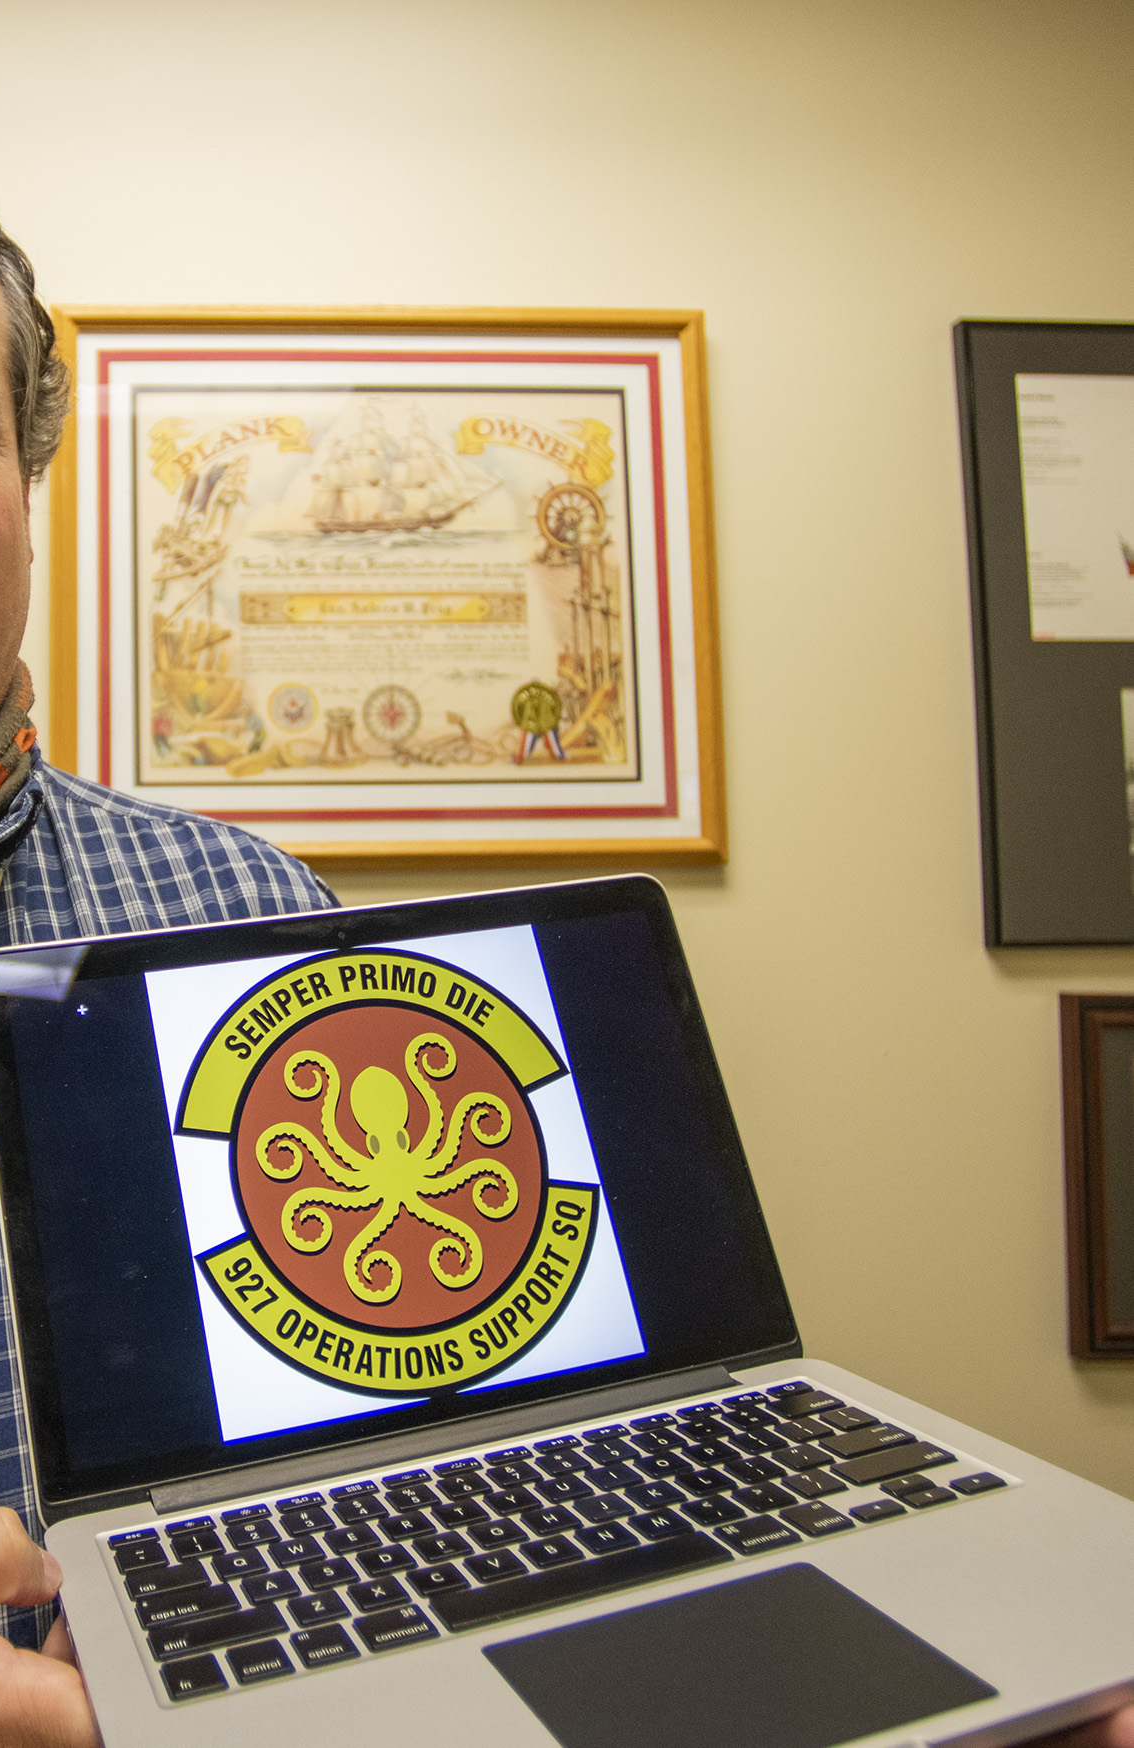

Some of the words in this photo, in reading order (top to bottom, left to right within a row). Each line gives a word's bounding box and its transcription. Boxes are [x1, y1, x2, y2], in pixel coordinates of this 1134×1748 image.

[173, 417, 291, 475] PLANK
[472, 417, 595, 484] OWNER
[224, 971, 333, 1060] SEMPER
[338, 963, 437, 999] PRIMO
[445, 981, 495, 1028] DIE
[224, 1256, 279, 1314] 927
[275, 1308, 465, 1380] OPERATIONS
[468, 1243, 571, 1360] SUPPORT
[551, 1199, 587, 1242] SQ
[703, 1447, 715, 1456] P
[555, 1482, 570, 1491] U
[698, 1477, 712, 1485] L
[646, 1488, 663, 1498] K
[505, 1494, 517, 1504] Y
[453, 1507, 465, 1516] T
[542, 1513, 558, 1524] H
[651, 1516, 671, 1528] M
[401, 1520, 414, 1529] R
[125, 1532, 142, 1540] esc
[250, 1532, 260, 1540] 2
[346, 1532, 358, 1542] E
[597, 1530, 615, 1541] N
[740, 1529, 791, 1548] command
[287, 1544, 304, 1555] W
[436, 1540, 446, 1550] F
[543, 1544, 558, 1555] B
[233, 1558, 248, 1567] Q
[378, 1553, 392, 1563] D
[487, 1557, 500, 1568] V
[322, 1567, 335, 1577] S
[430, 1572, 445, 1583] C
[139, 1583, 157, 1593] tab
[265, 1581, 279, 1591] A
[370, 1586, 387, 1598] X
[311, 1601, 326, 1612] Z
[150, 1609, 176, 1622] caps
[177, 1604, 200, 1616] lock
[374, 1622, 430, 1643] command
[163, 1639, 188, 1652] shift
[308, 1645, 345, 1660] option
[243, 1658, 282, 1675] control
[179, 1680, 193, 1691] fn
